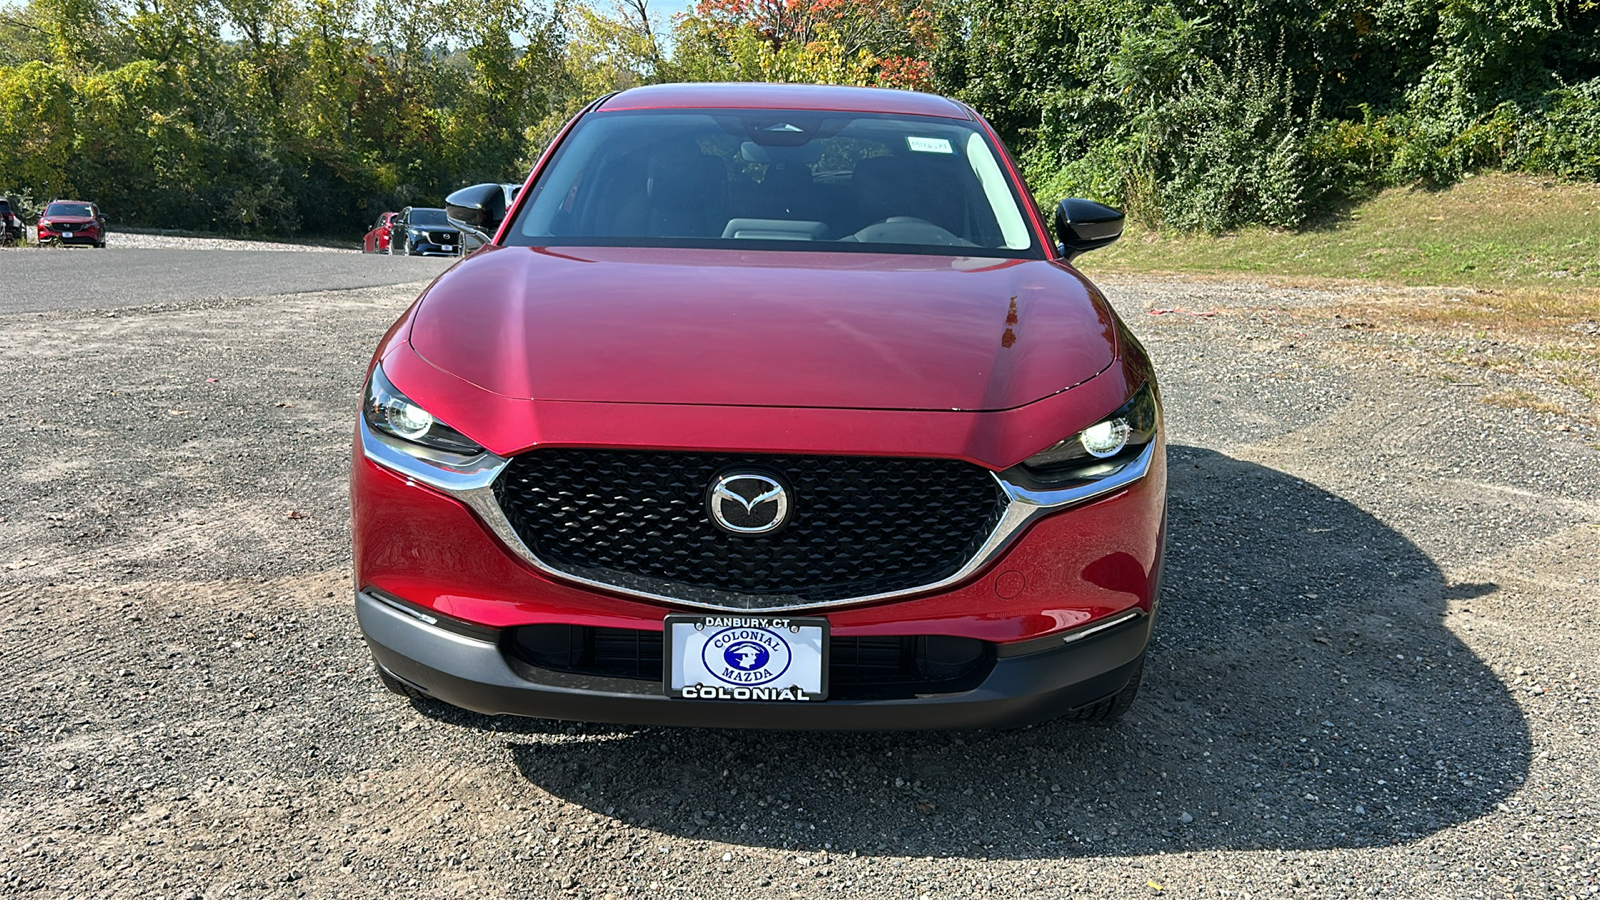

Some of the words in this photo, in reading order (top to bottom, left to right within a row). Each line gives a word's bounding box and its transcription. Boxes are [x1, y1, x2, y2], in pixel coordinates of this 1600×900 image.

[705, 617, 769, 628] DANBURY,
[772, 619, 790, 629] CT
[714, 630, 781, 652] COLONIAL
[721, 667, 774, 682] MAZDA
[682, 687, 810, 700] COLONIAL
